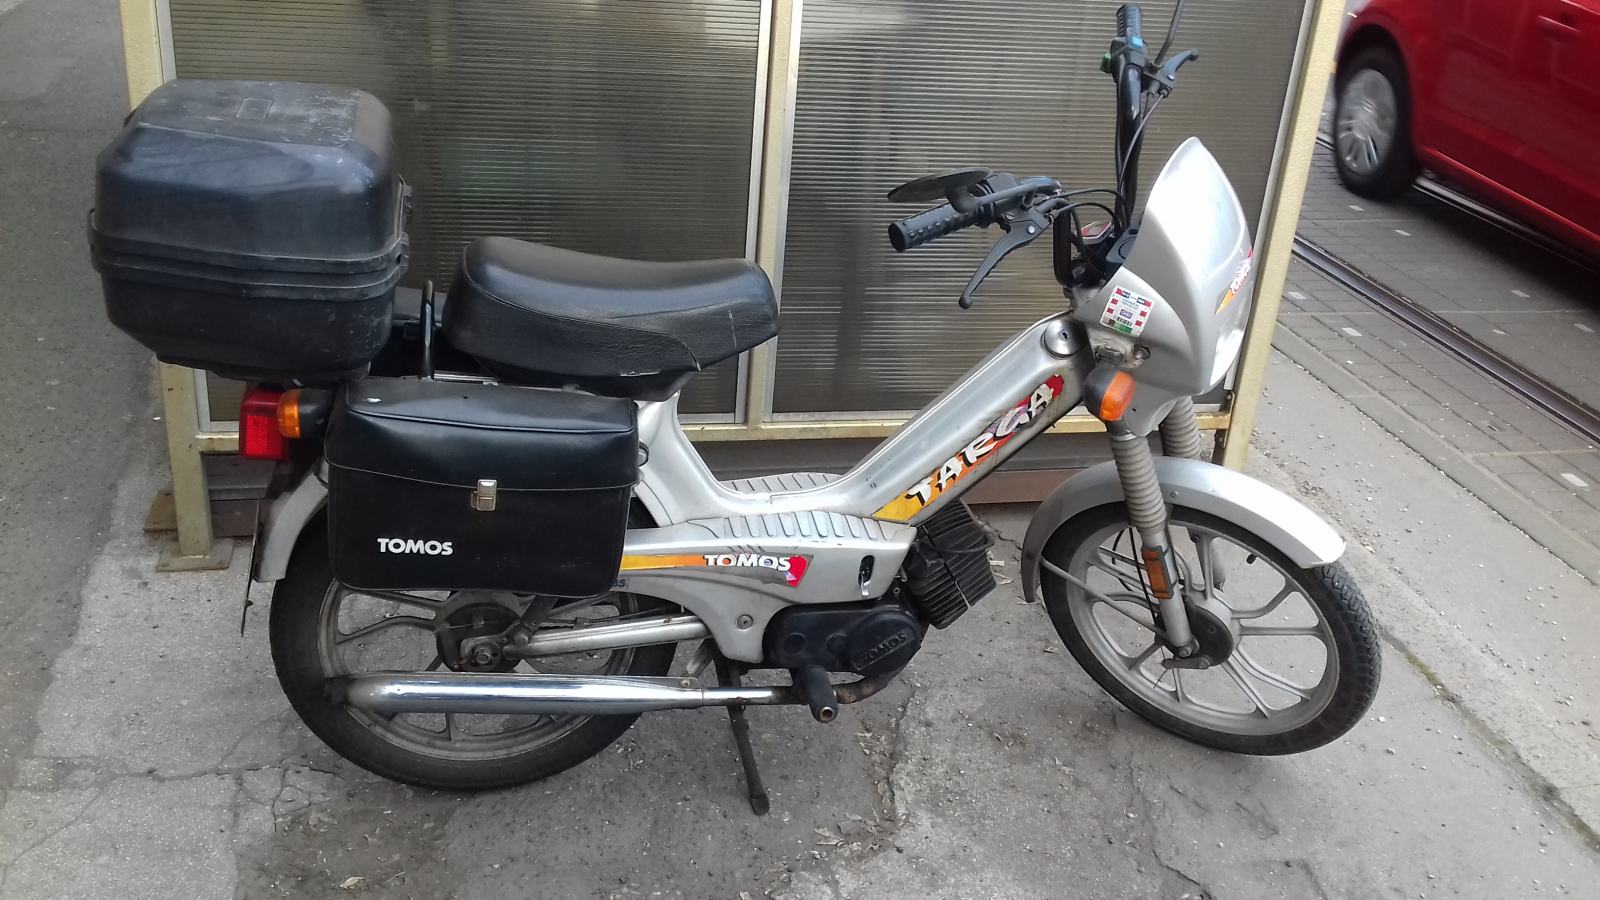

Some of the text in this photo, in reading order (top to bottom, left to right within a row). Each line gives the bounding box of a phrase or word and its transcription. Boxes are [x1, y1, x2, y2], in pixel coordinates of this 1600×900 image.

[905, 383, 1055, 506] TARGA
[377, 537, 453, 556] TOMOS
[703, 553, 791, 571] TOMOS
